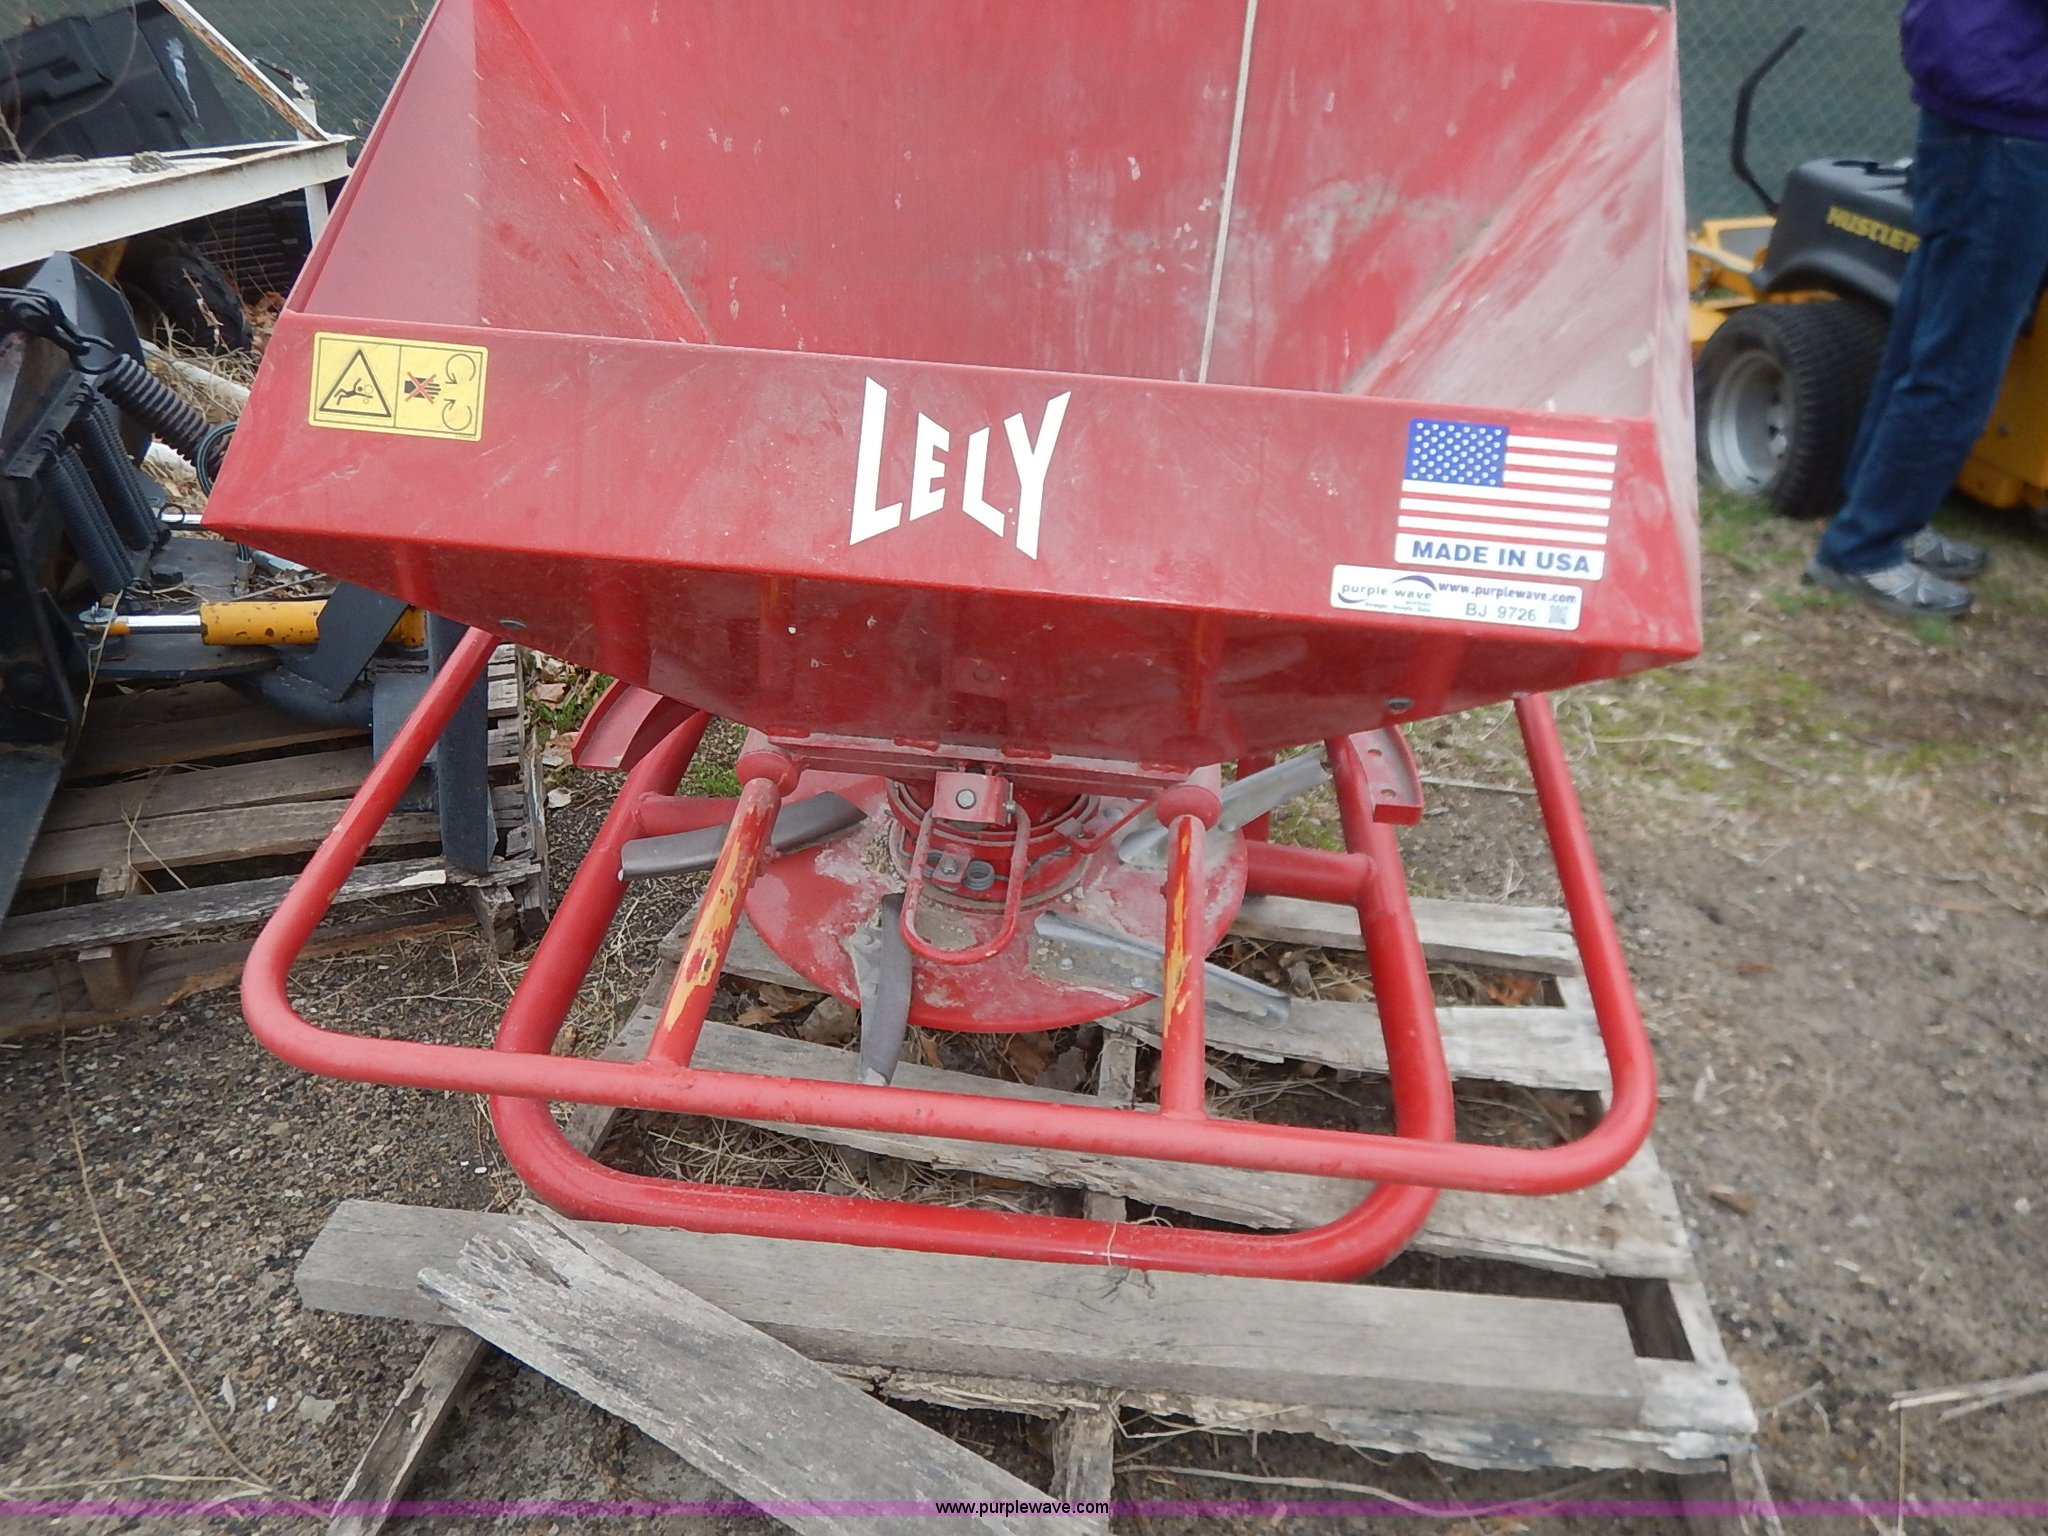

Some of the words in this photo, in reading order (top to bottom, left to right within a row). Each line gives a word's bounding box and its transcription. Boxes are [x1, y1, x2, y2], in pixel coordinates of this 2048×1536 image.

[850, 376, 1071, 560] LELY
[1412, 540, 1489, 564] MADE
[1498, 548, 1526, 567] IN
[1536, 551, 1590, 573] USA
[1341, 584, 1388, 597] purple
[1395, 589, 1432, 600] wave
[1438, 582, 1577, 604] www.purplewave.com
[1465, 602, 1488, 618] BJ
[1497, 605, 1537, 622] 9726
